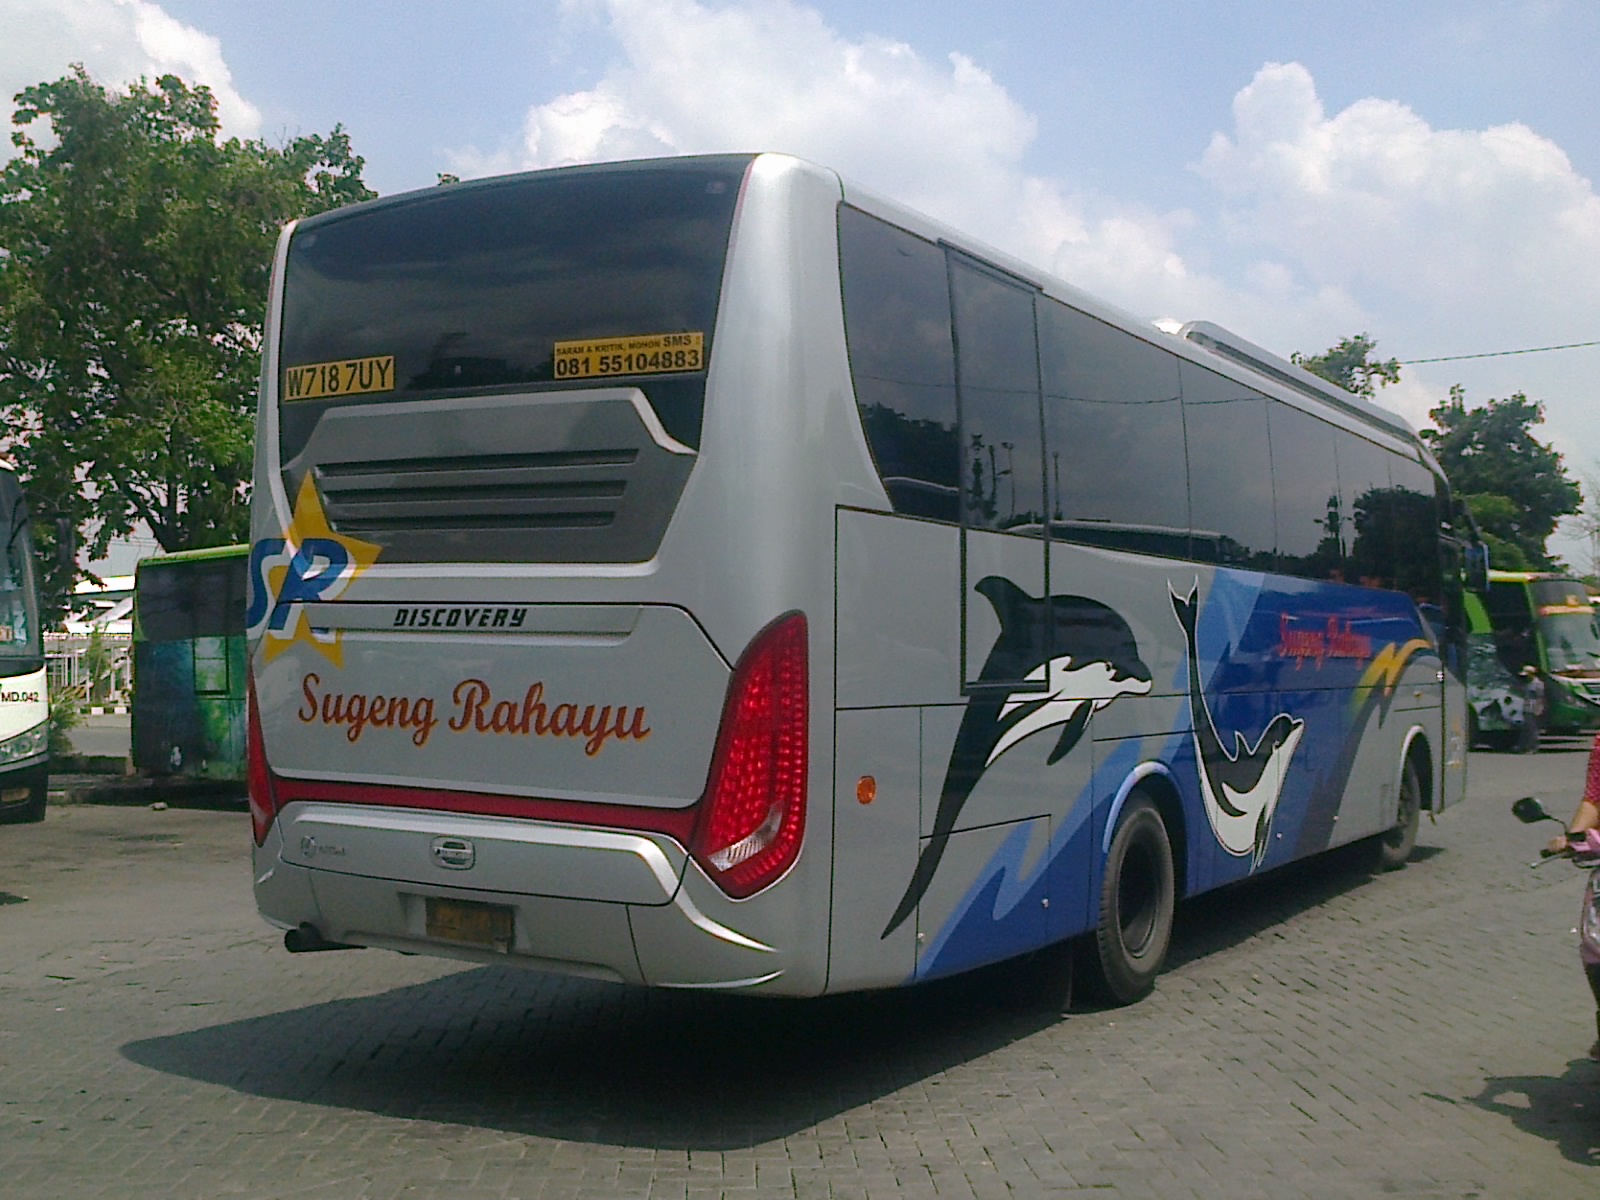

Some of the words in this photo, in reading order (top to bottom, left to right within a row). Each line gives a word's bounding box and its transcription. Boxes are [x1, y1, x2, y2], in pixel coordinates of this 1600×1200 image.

[663, 335, 692, 348] SMS
[556, 357, 591, 376] 081
[599, 350, 700, 373] 55104883
[393, 608, 528, 627] DISCOVERY
[299, 673, 438, 746] Sugeng
[449, 679, 651, 756] Rahayu
